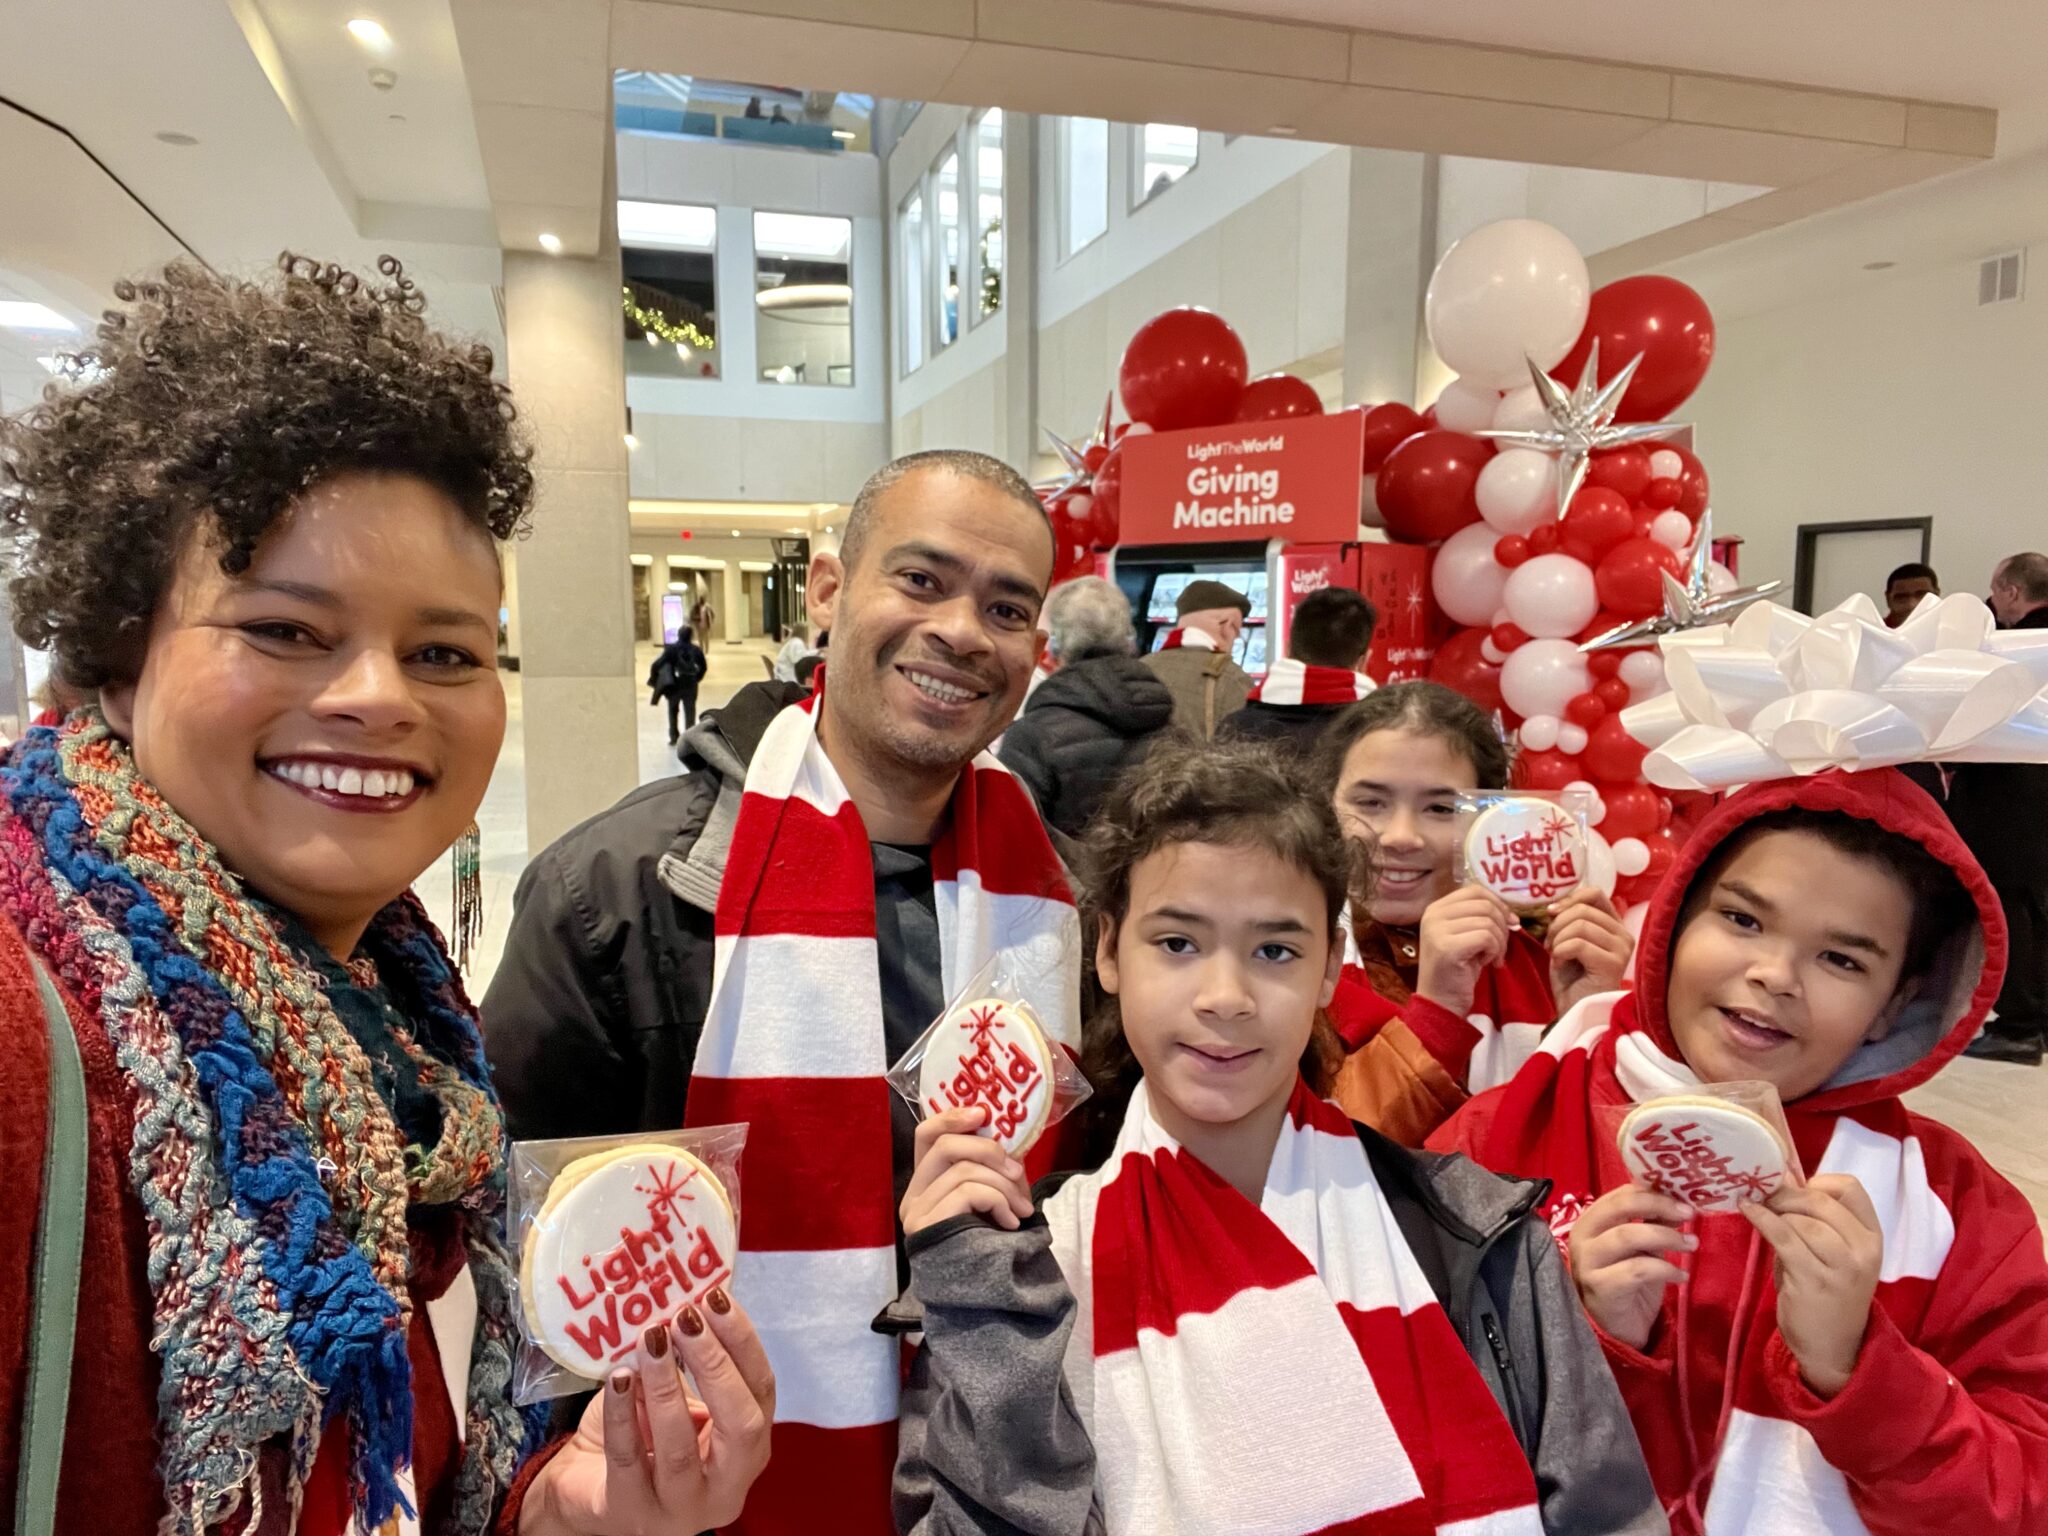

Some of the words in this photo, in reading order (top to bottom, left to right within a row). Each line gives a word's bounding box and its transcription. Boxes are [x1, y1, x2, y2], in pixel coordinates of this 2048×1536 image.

[1187, 435, 1284, 461] LightTheWorld
[1186, 463, 1279, 500] Giving
[1173, 496, 1295, 529] Machine
[1294, 569, 1324, 583] Light
[1486, 831, 1554, 862] Light
[1480, 851, 1576, 884] World
[1634, 1122, 1730, 1209] World
[1670, 1121, 1745, 1185] Light
[557, 1206, 674, 1311] Light
[564, 1225, 724, 1361] World
